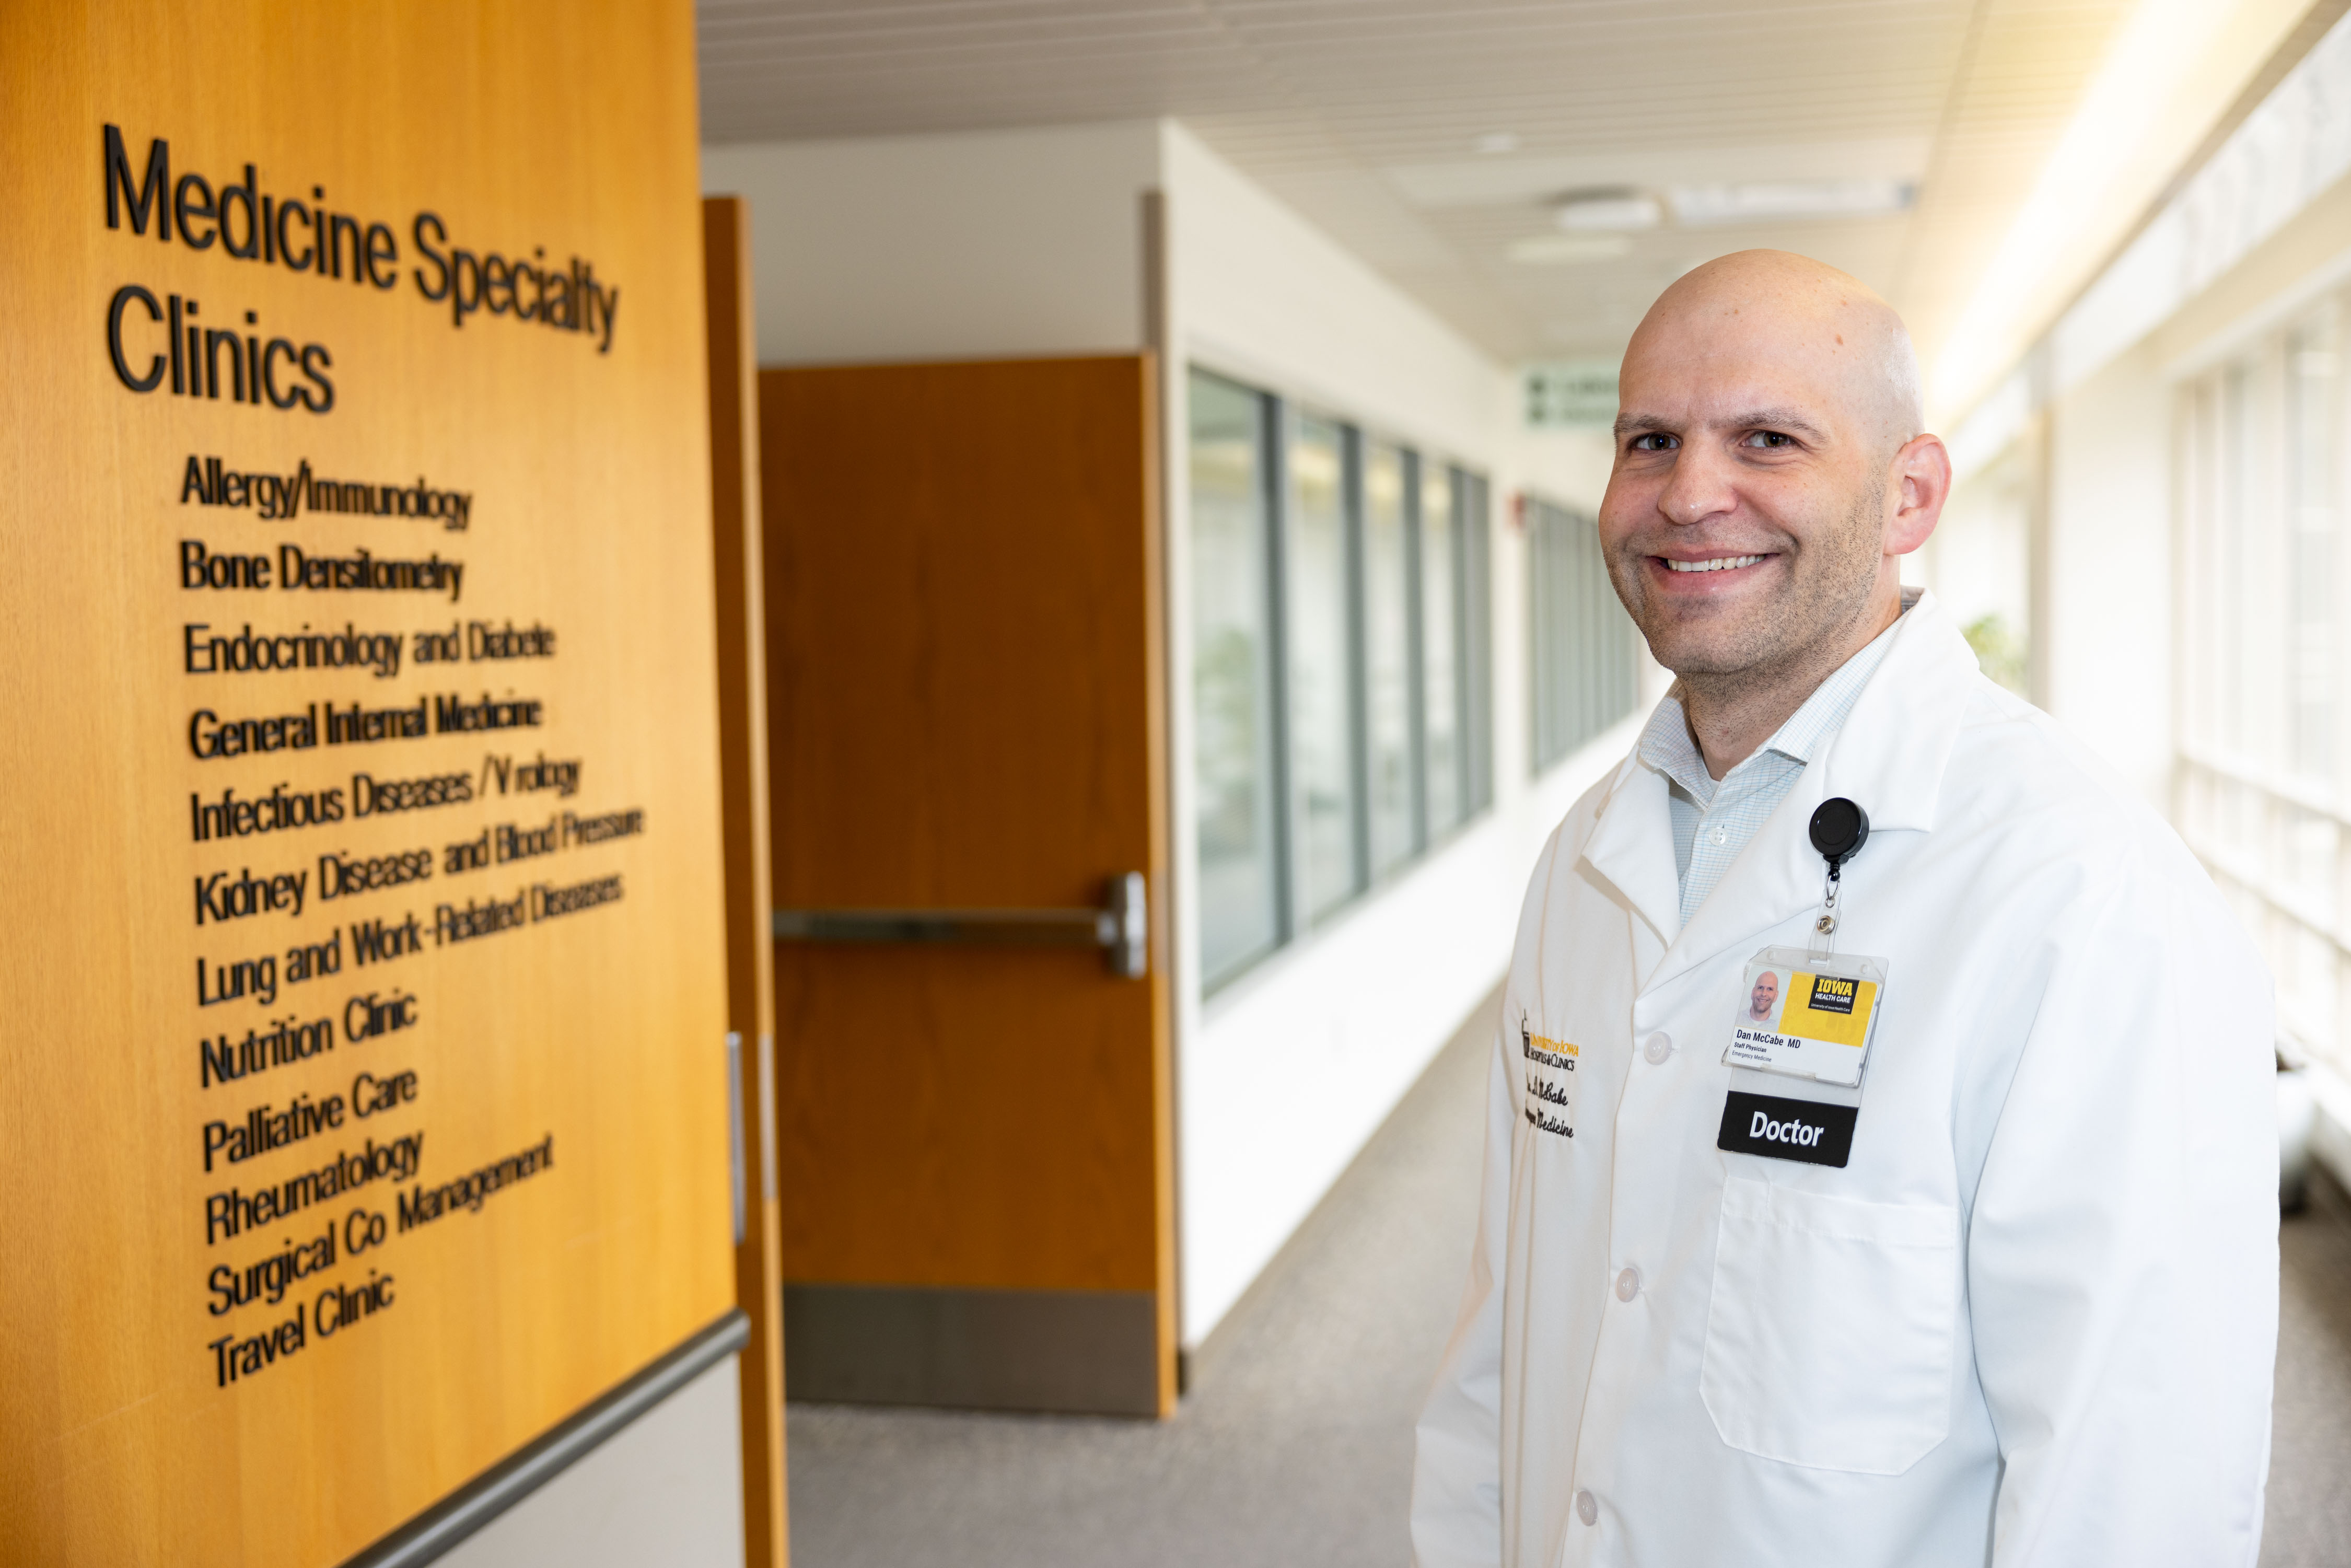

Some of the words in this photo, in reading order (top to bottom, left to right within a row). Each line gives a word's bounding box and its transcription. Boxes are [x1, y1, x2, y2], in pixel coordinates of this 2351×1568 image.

[103, 123, 398, 290] Medicine
[414, 211, 619, 355] Specialty
[108, 284, 334, 414] Clinics
[181, 455, 473, 531] Allergy/Immunology
[180, 540, 270, 589] Bone
[279, 543, 463, 603] Densitometry
[184, 623, 404, 678] Endocrinology
[413, 618, 460, 664] and
[189, 702, 317, 759] General
[325, 695, 427, 745] Internal
[436, 687, 542, 733] Medicine
[191, 783, 344, 841] Infectious
[353, 770, 473, 818] Diseases
[195, 867, 308, 926] Kidney
[319, 848, 432, 901] Disease
[444, 826, 491, 875] and
[495, 811, 557, 864] Blood
[563, 806, 646, 850] Pressure
[197, 956, 276, 1006] Lung
[286, 928, 341, 983] and
[531, 871, 623, 923] Diseases
[1815, 993, 1836, 1001] HEALTH
[1817, 979, 1853, 996] IOWA
[201, 1015, 333, 1089] Nutrition
[344, 988, 417, 1043] Clinic
[1551, 1053, 1574, 1071] CLINICS
[1559, 1039, 1578, 1057] IOWA
[1732, 1050, 1753, 1059] Emergency
[1737, 1029, 1751, 1040] Dan
[1753, 1032, 1784, 1046] McCabe
[1787, 1038, 1800, 1048] MD
[1745, 1044, 1766, 1052] Physician
[204, 1093, 344, 1172] Palliative
[352, 1068, 417, 1119] Care
[1537, 1108, 1574, 1138] Medicine
[1749, 1111, 1824, 1147] Doctor
[206, 1130, 423, 1246] Rheumatology
[209, 1220, 335, 1317] Surgical
[344, 1206, 386, 1255] Co
[397, 1130, 554, 1235] Management
[208, 1304, 305, 1388] Travel
[315, 1269, 394, 1339] Clinic
